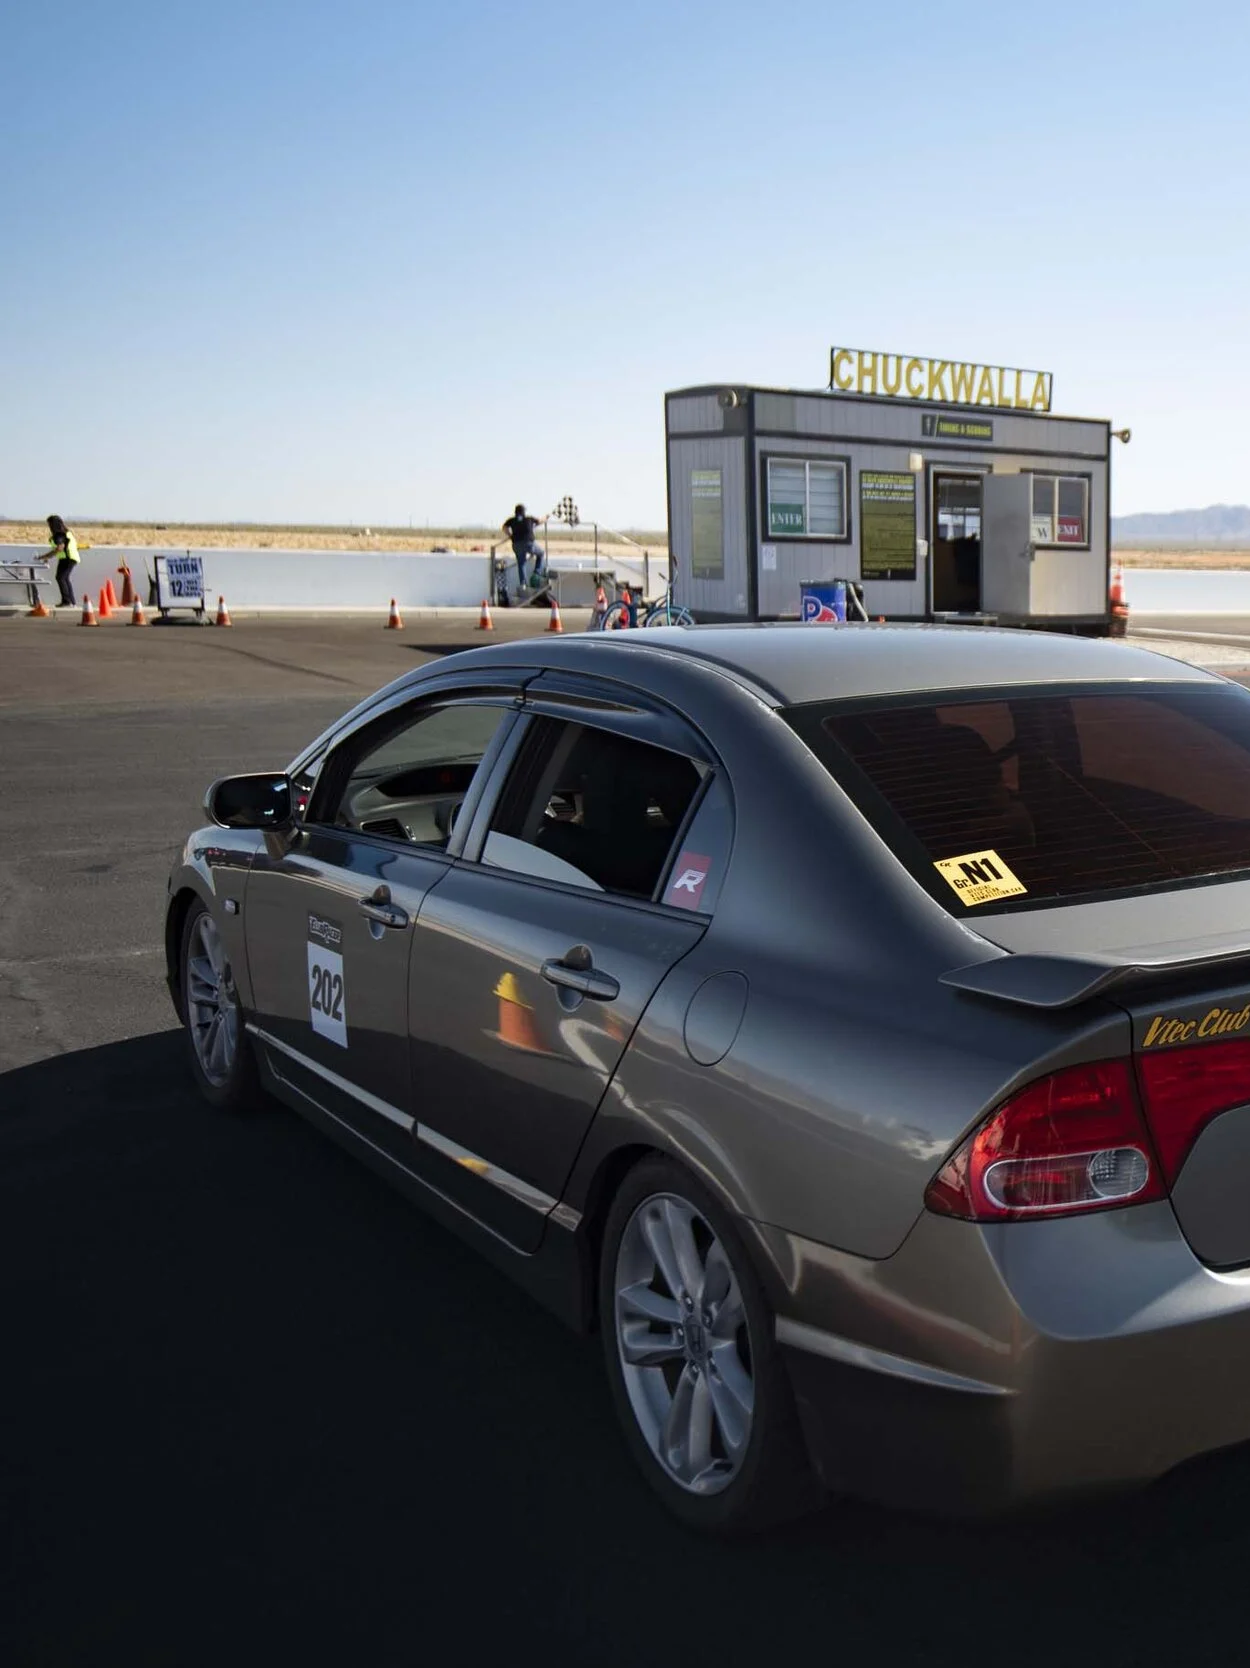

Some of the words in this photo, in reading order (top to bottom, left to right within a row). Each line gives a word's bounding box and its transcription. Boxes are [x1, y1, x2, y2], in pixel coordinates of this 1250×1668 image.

[833, 349, 1049, 411] CHUCKWALLA
[168, 563, 199, 575] TURN
[170, 580, 185, 598] 12
[953, 878, 972, 889] Gr.
[958, 857, 1004, 886] N1
[311, 964, 343, 1022] 202
[1142, 1016, 1197, 1048] Vtec
